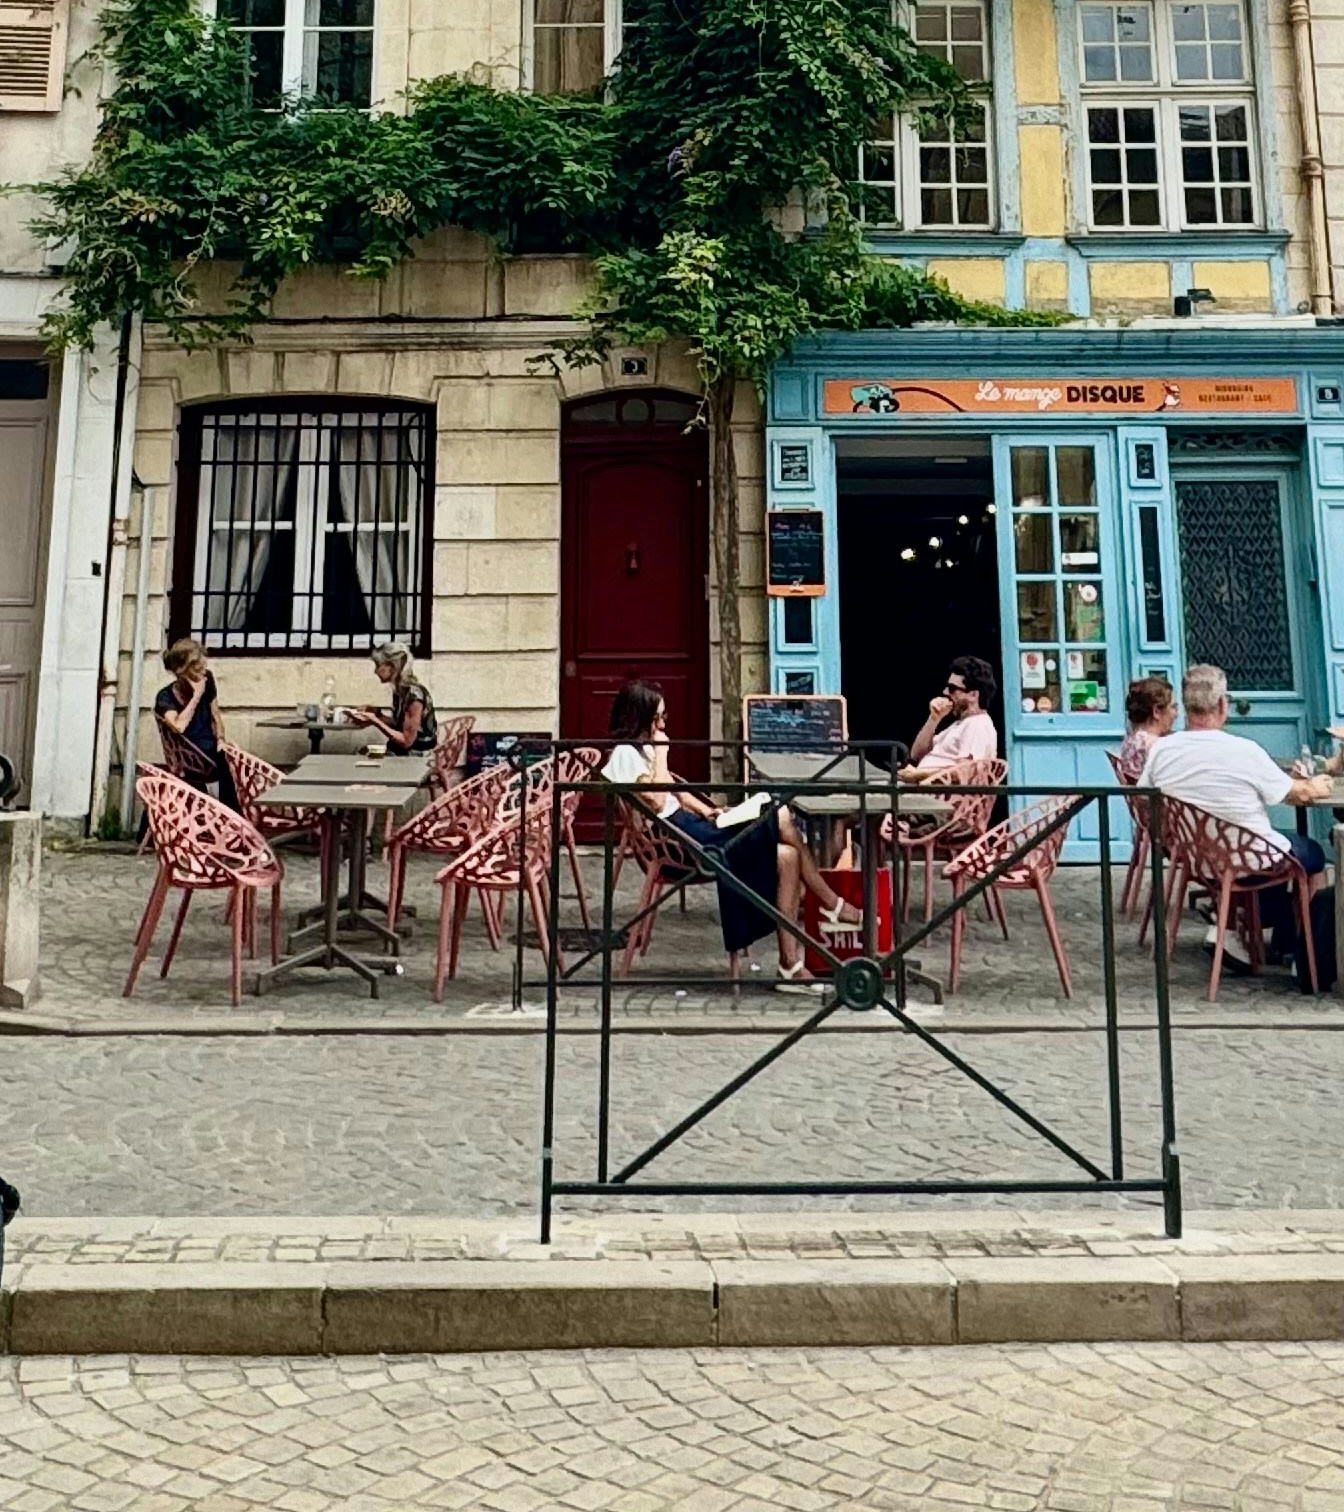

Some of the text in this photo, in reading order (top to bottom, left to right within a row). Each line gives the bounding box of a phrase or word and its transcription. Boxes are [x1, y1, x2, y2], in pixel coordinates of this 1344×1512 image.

[975, 380, 1145, 410] Le mange DISQUE
